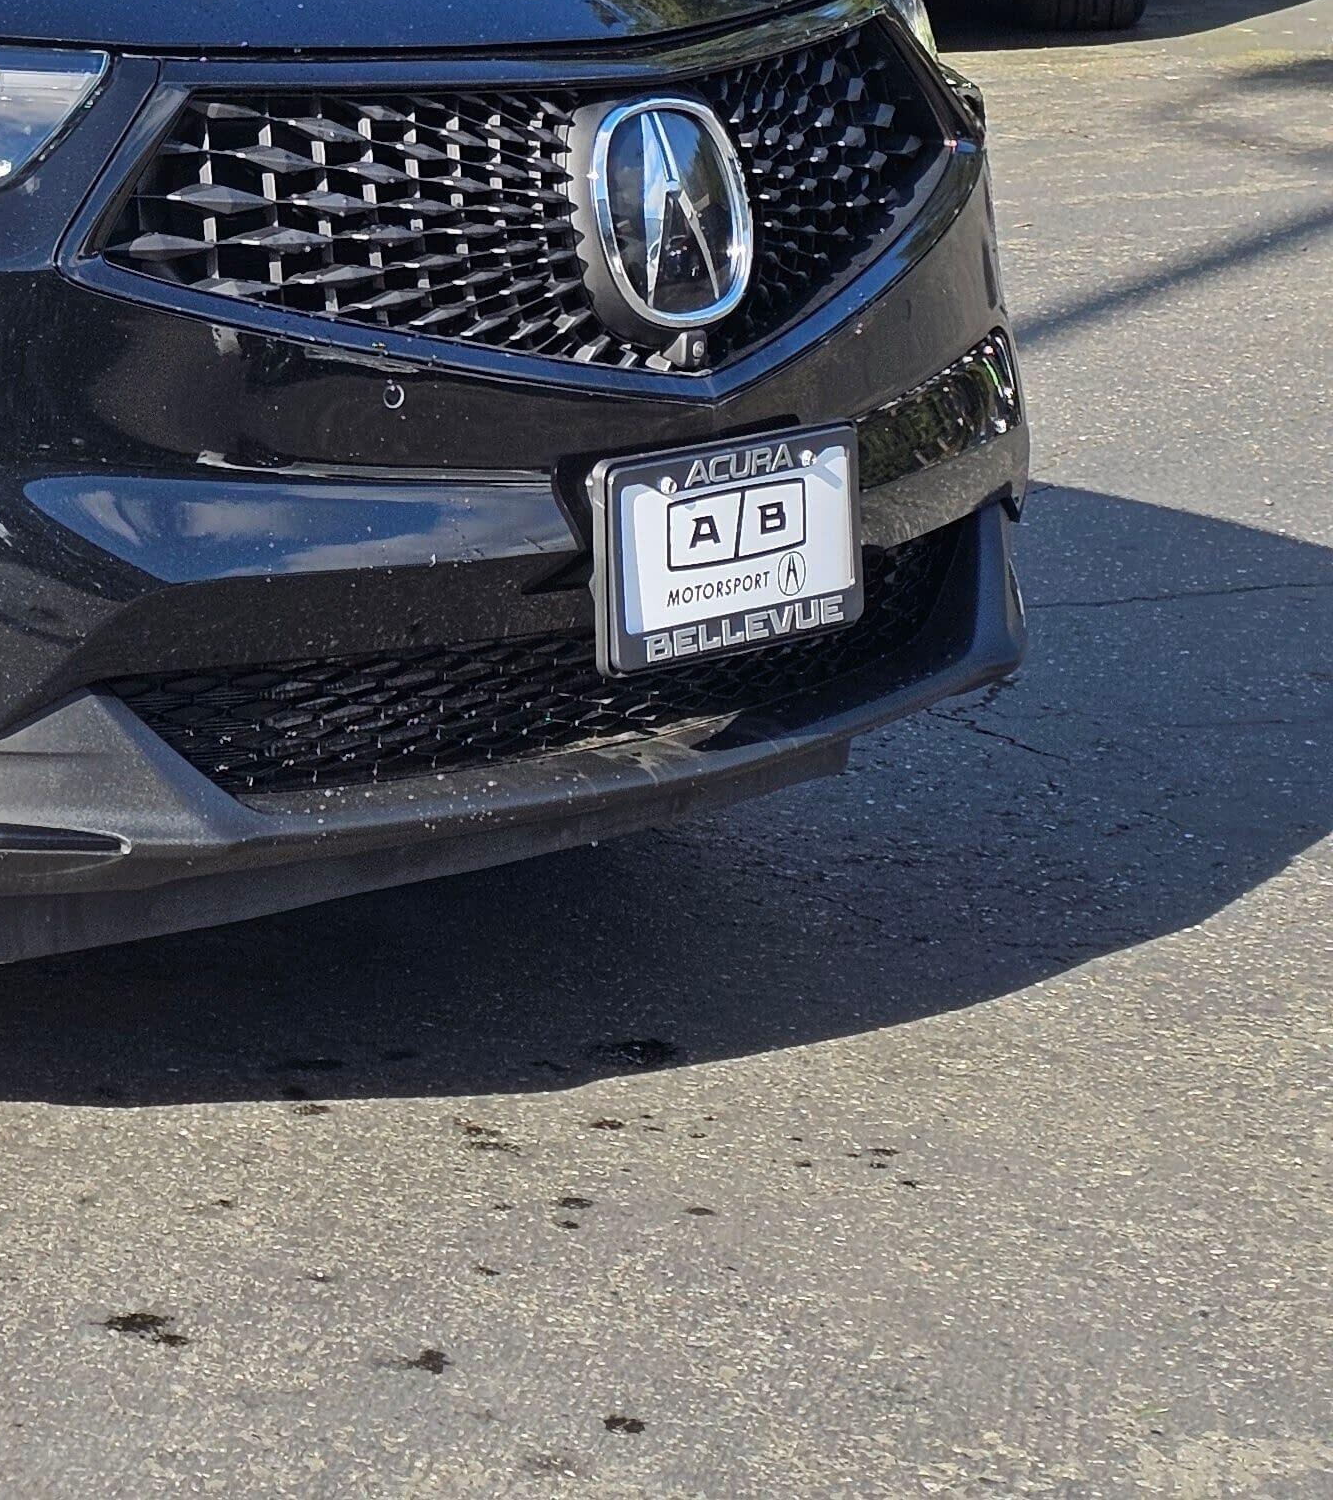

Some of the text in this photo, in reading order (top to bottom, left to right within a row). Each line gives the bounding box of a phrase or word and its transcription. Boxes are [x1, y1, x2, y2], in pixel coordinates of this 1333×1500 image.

[684, 443, 794, 488] ACURA
[666, 570, 771, 607] MOTORSPORT
[644, 594, 845, 663] BELLEVUE
